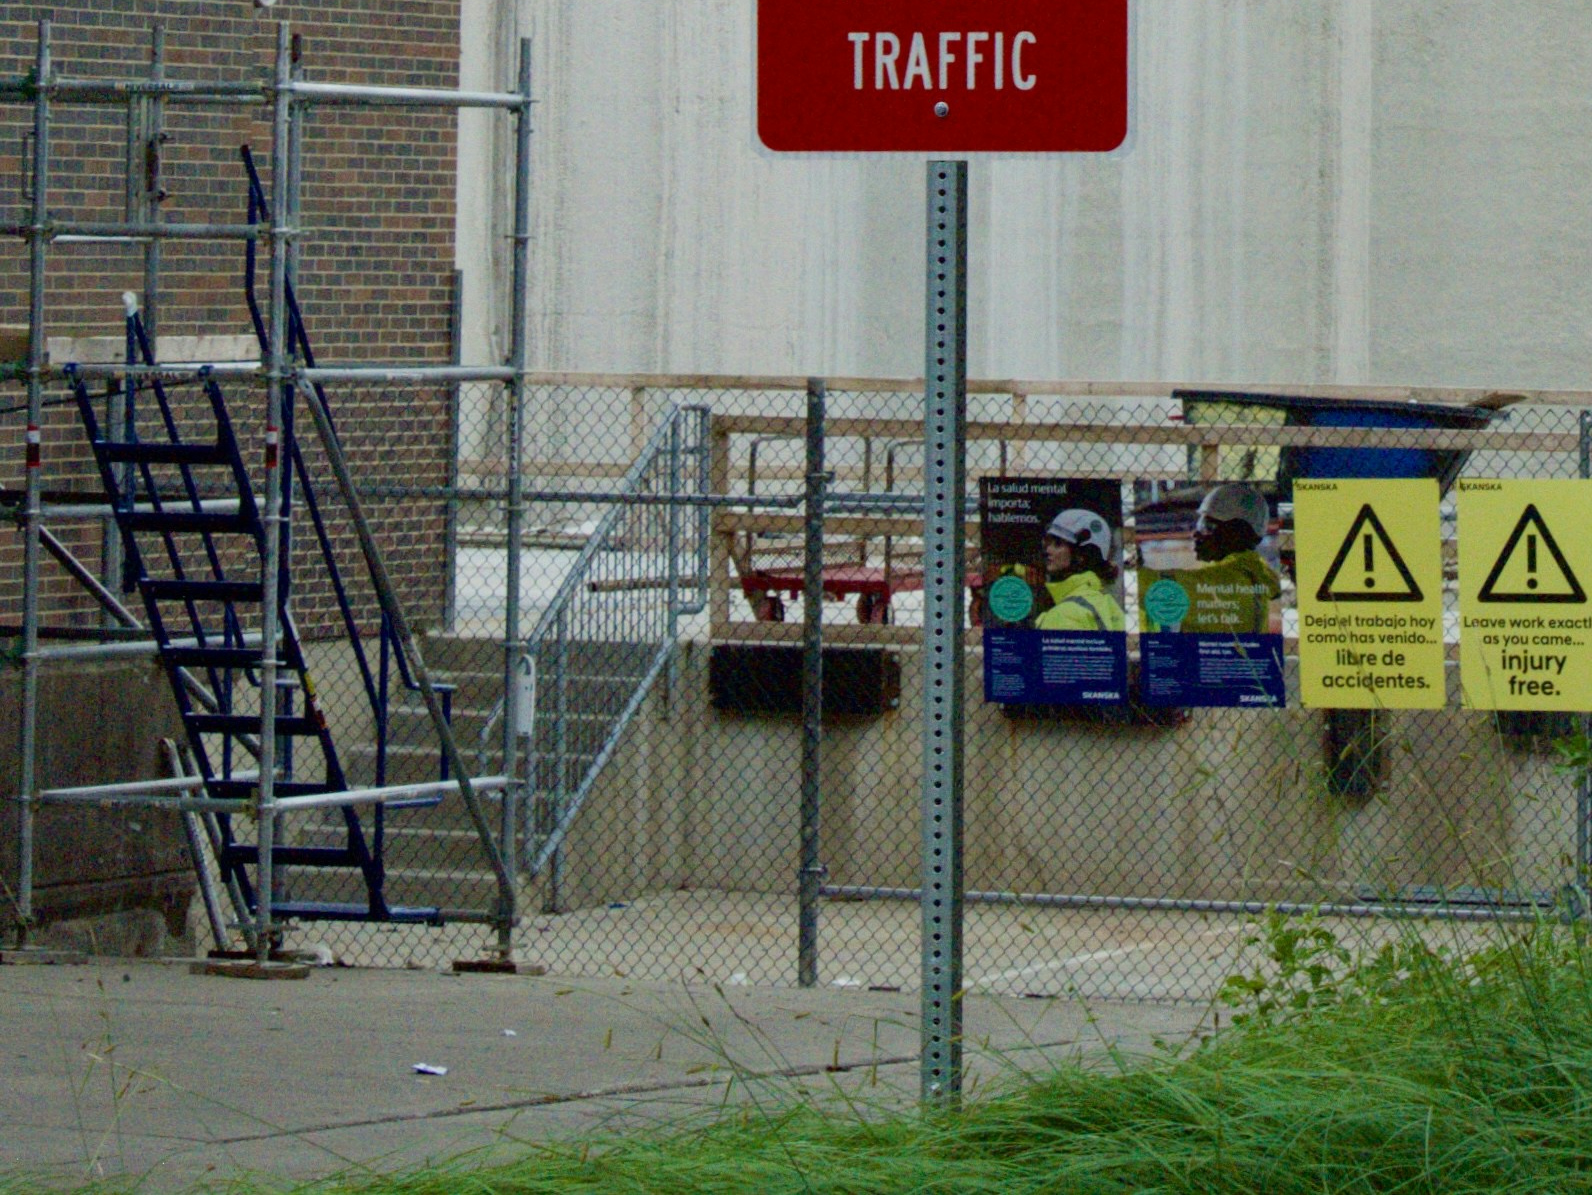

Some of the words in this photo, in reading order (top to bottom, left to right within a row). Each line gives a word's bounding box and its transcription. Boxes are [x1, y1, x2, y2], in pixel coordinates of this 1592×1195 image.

[848, 31, 1037, 91] TRAFFIC
[987, 483, 999, 493] La
[1001, 483, 1029, 494] salud
[1030, 484, 1067, 494] mental
[1296, 483, 1338, 491] SKANSKA
[1461, 483, 1503, 491] SKANSKA
[1196, 584, 1233, 594] Mental
[1236, 584, 1269, 594] health
[1304, 615, 1336, 629] Deja
[1339, 615, 1352, 627] el
[1355, 615, 1406, 629] trabajo
[1409, 615, 1436, 629] hoy
[1463, 616, 1506, 628] Leave
[1509, 616, 1545, 628] work
[1307, 633, 1346, 643] como
[1350, 632, 1375, 643] has
[1378, 632, 1437, 644] venido...
[1483, 635, 1499, 645] as
[1503, 635, 1529, 647] you
[1532, 635, 1585, 645] came...
[1336, 649, 1377, 666] libre
[1382, 650, 1405, 666] de
[1501, 650, 1567, 675] injury
[1322, 672, 1430, 689] accidentes.
[1509, 676, 1561, 696] free.
